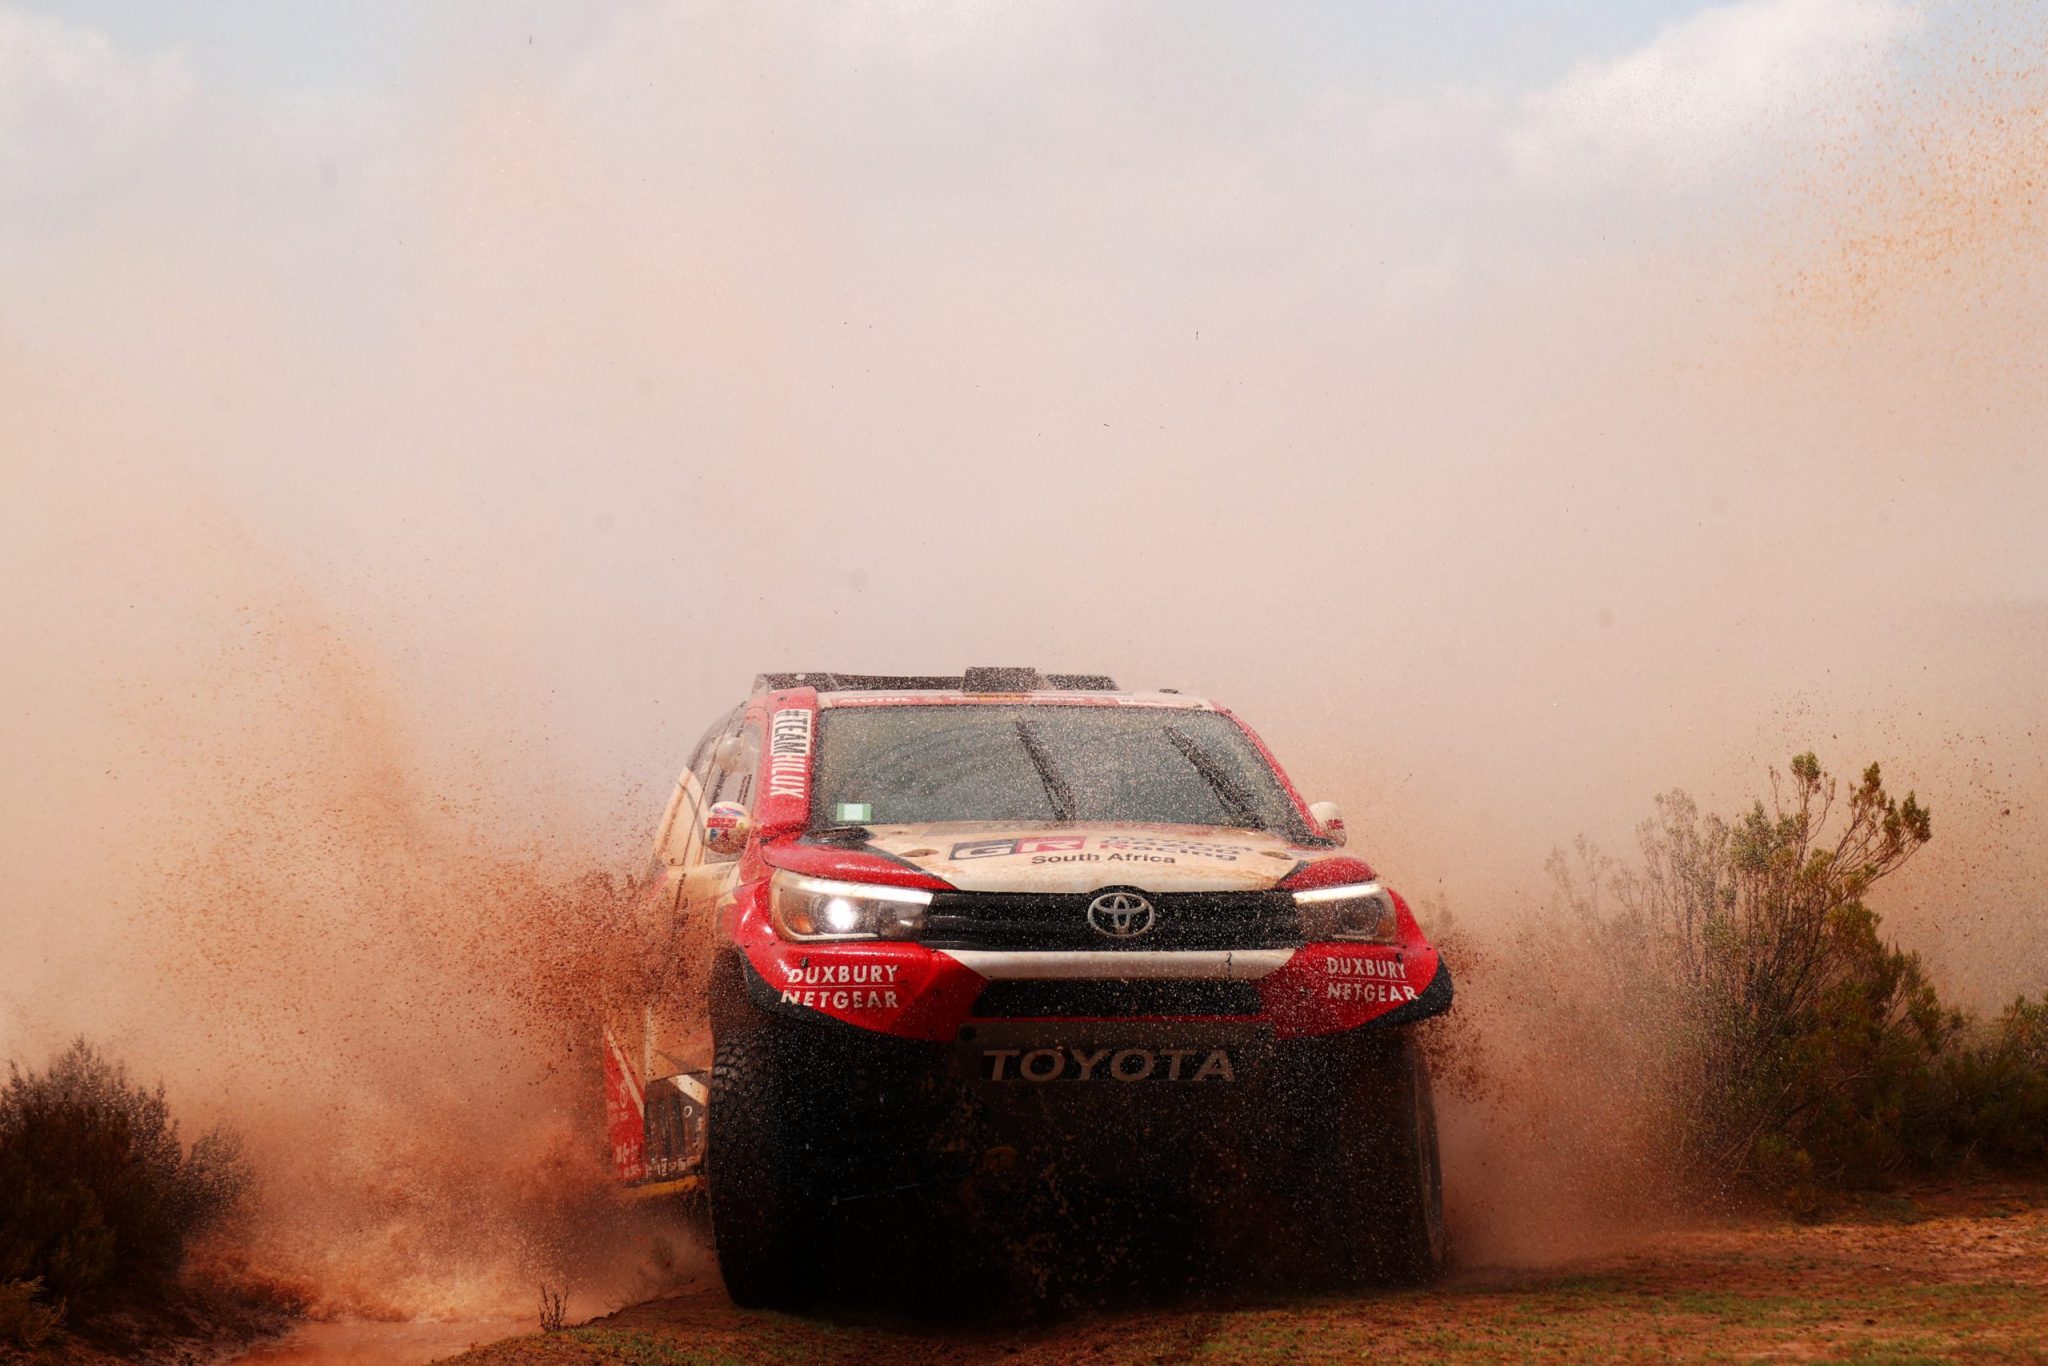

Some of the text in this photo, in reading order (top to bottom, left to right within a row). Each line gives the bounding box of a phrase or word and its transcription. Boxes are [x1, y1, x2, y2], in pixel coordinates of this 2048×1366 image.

[770, 709, 809, 799] #TEAMHILUX
[1032, 852, 1177, 865] South Africa
[787, 964, 898, 984] DUXBURY
[1326, 956, 1407, 979] DUXBURY
[780, 989, 899, 1009] NETGEAR
[1326, 982, 1420, 1002] NETGEAR
[983, 1048, 1236, 1082] TOYOTA
